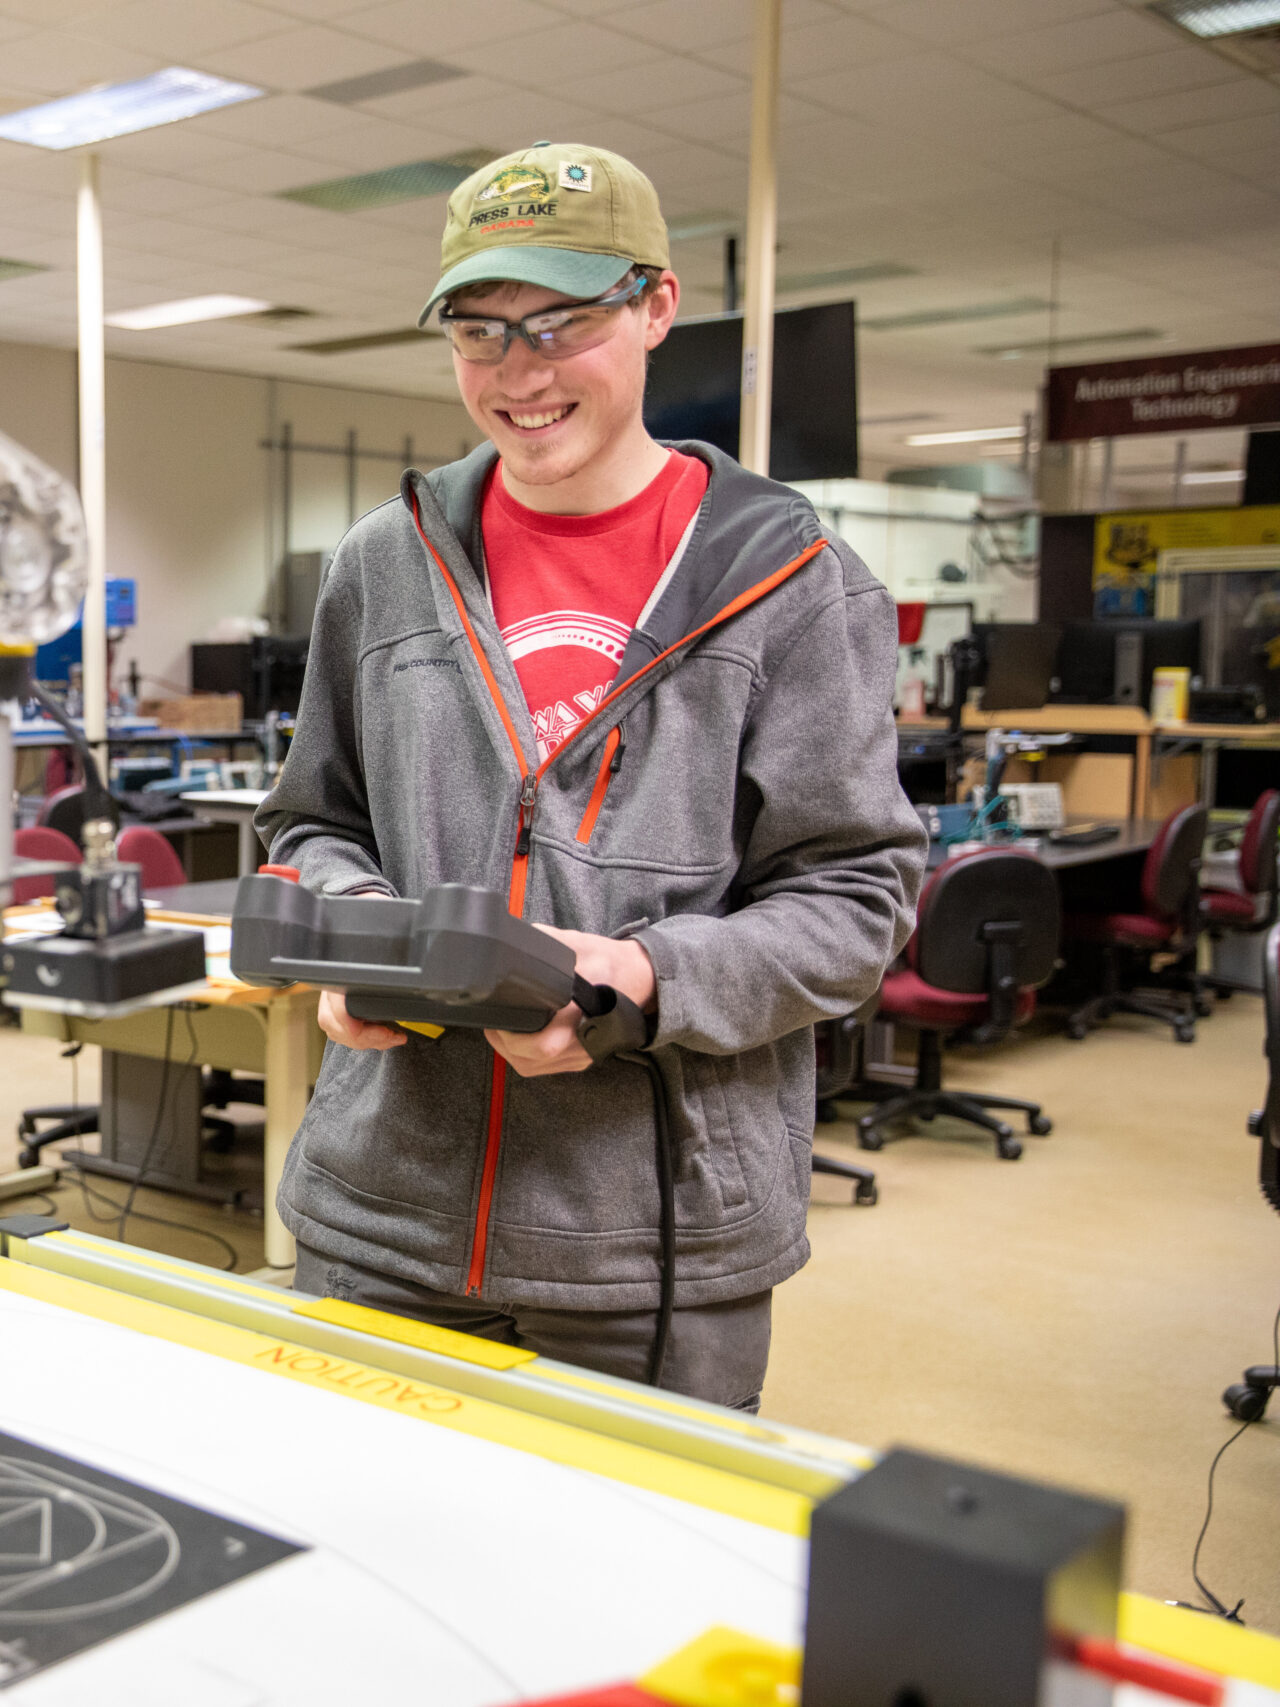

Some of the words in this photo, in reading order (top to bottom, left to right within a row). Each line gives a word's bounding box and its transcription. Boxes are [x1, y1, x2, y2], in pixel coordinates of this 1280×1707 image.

[468, 207, 510, 228] PRESS
[517, 203, 558, 217] LAKE
[1074, 371, 1182, 402] Automation
[1131, 393, 1240, 421] Technology
[254, 1346, 463, 1413] CAUTION
